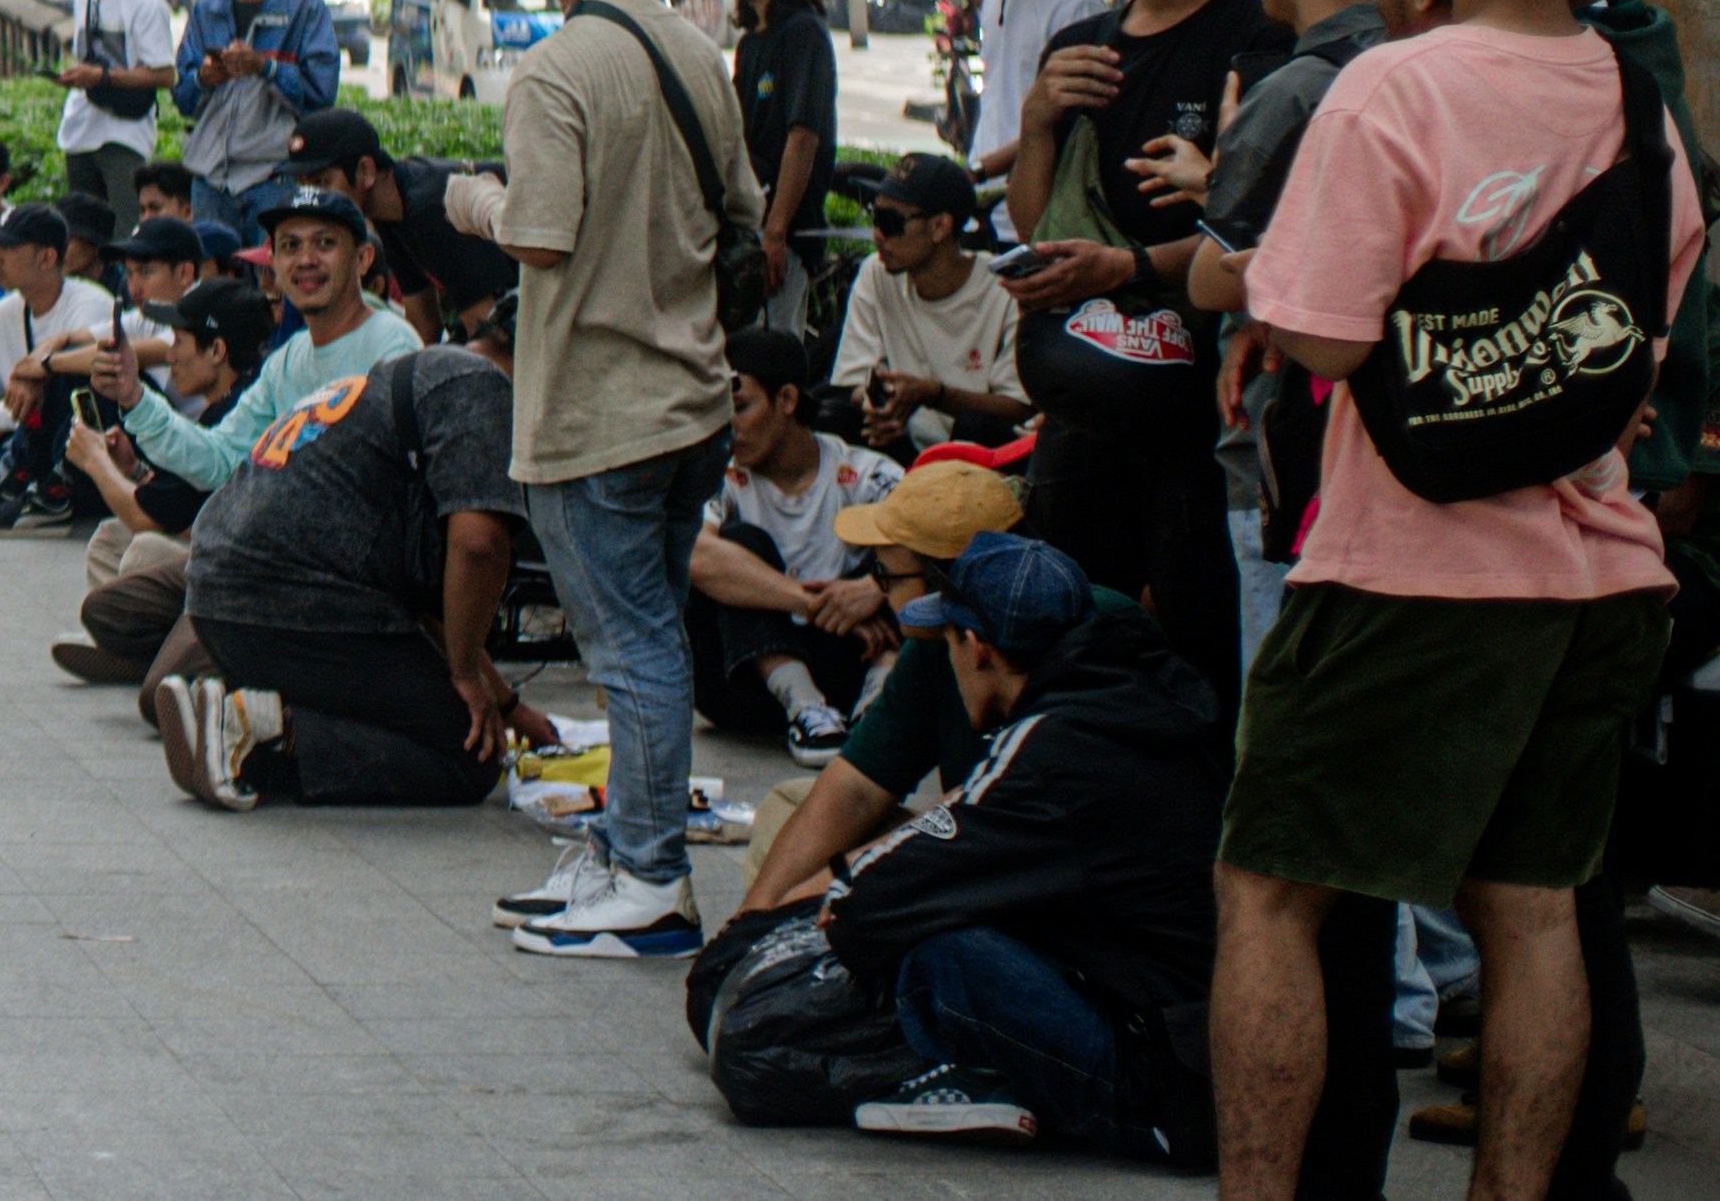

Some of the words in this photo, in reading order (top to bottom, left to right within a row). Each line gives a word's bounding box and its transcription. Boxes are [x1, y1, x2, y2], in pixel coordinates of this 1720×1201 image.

[1127, 318, 1160, 339] THE
[1453, 307, 1501, 330] MADE
[1117, 335, 1164, 360] VANS
[1444, 361, 1521, 406] Supply
